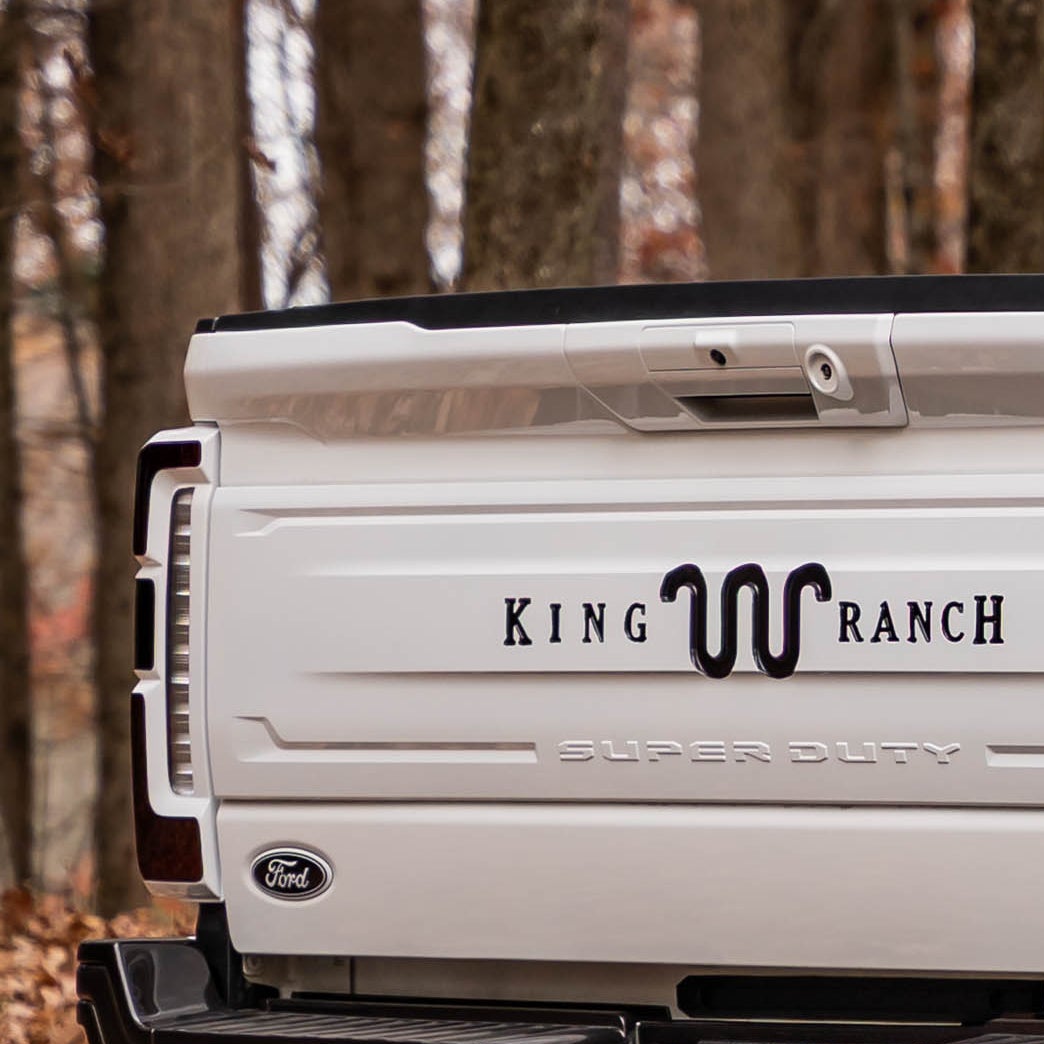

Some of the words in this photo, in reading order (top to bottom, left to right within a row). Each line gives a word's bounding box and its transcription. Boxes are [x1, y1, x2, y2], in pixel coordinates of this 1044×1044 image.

[503, 597, 648, 646] KING
[838, 595, 1005, 645] RANCH
[557, 740, 771, 763] SUPER
[788, 741, 961, 764] DUTY
[265, 858, 310, 888] Ford
